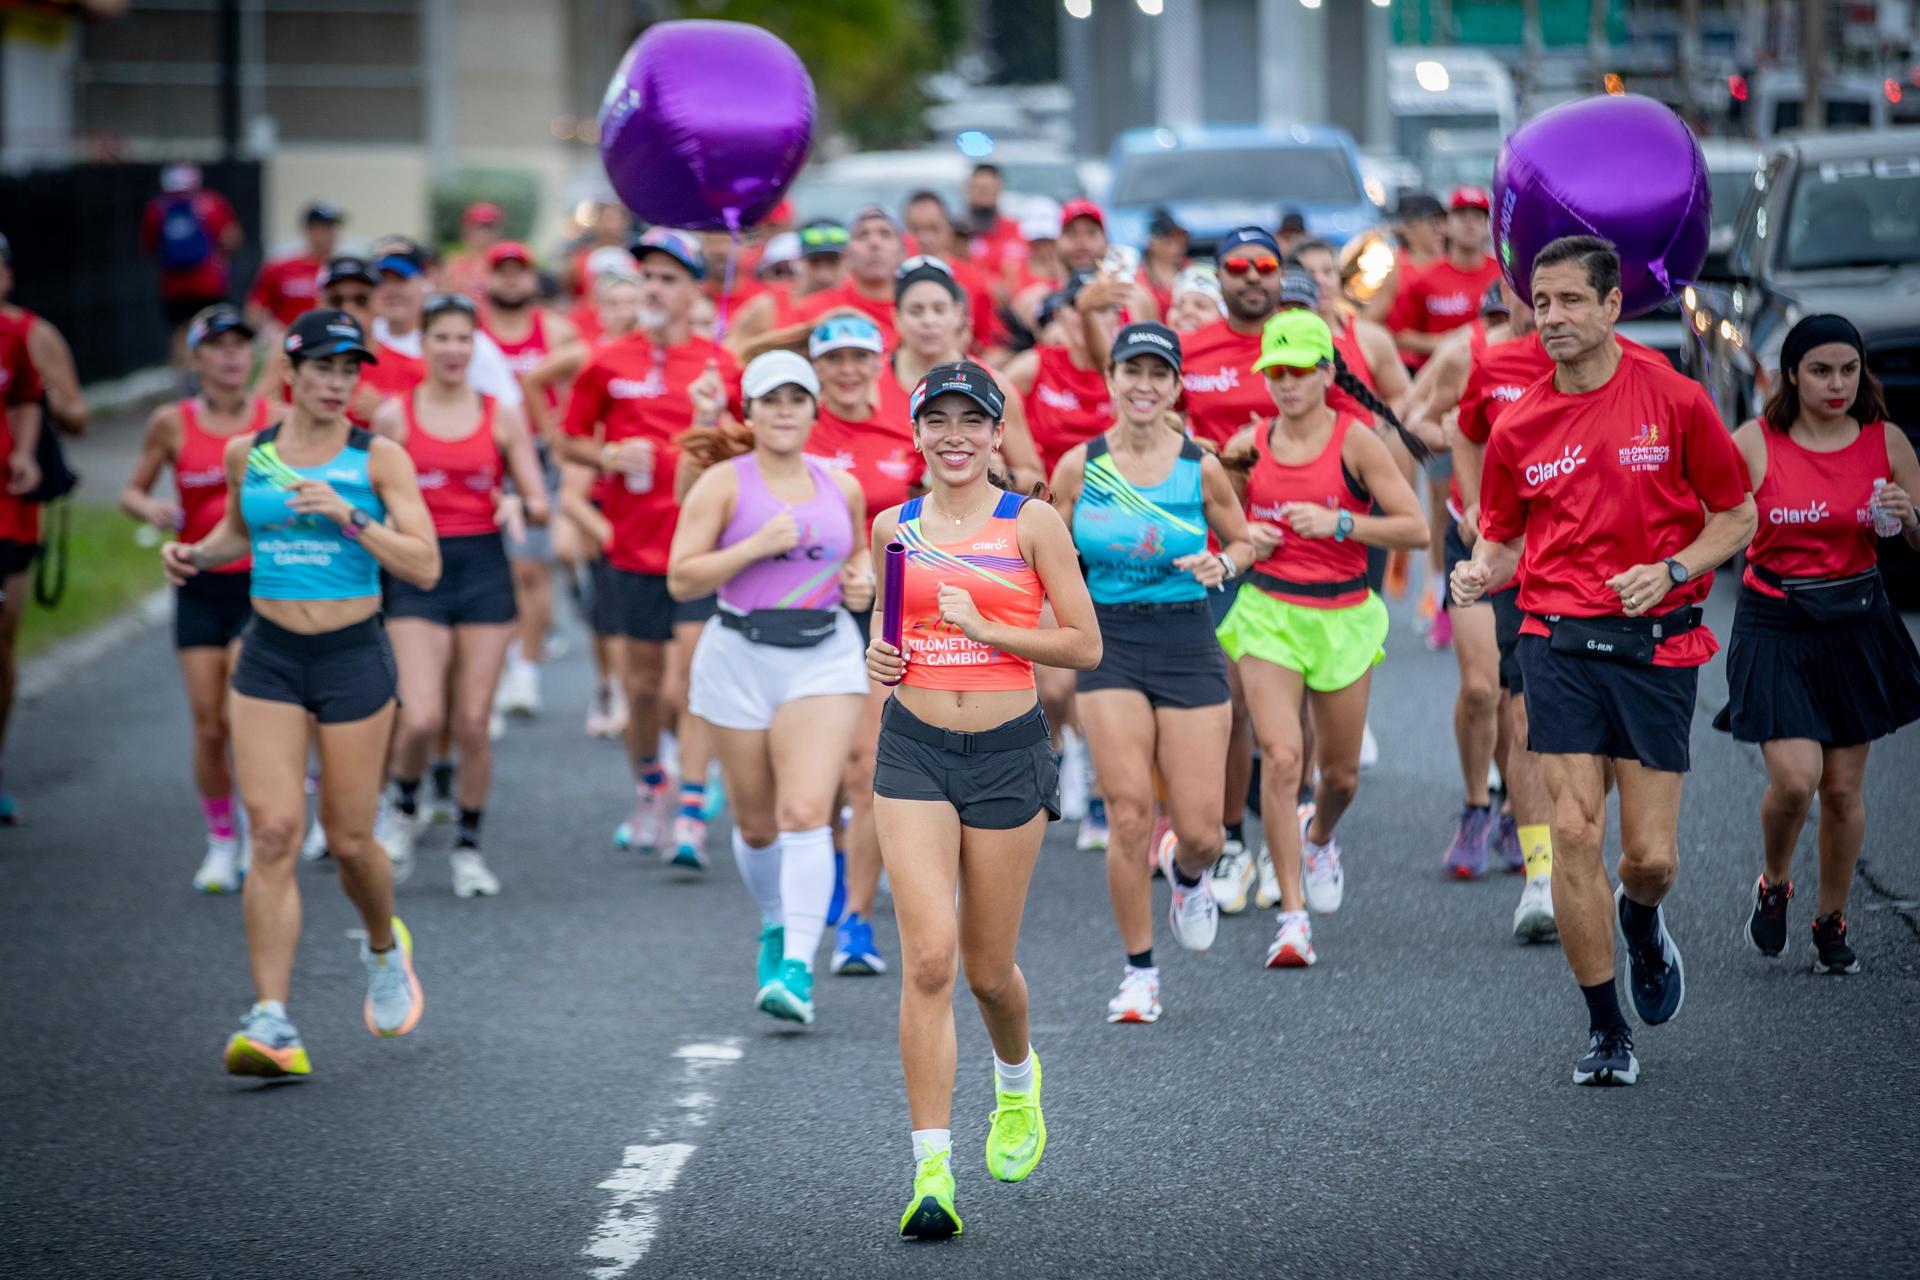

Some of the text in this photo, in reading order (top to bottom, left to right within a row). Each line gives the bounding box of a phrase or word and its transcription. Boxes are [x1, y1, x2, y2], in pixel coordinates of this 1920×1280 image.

[1525, 445, 1585, 487] Claro
[1769, 501, 1828, 524] Claro
[972, 538, 1008, 550] Claro
[909, 636, 991, 651] KILÓMETRO
[927, 651, 989, 665] CAMBIO
